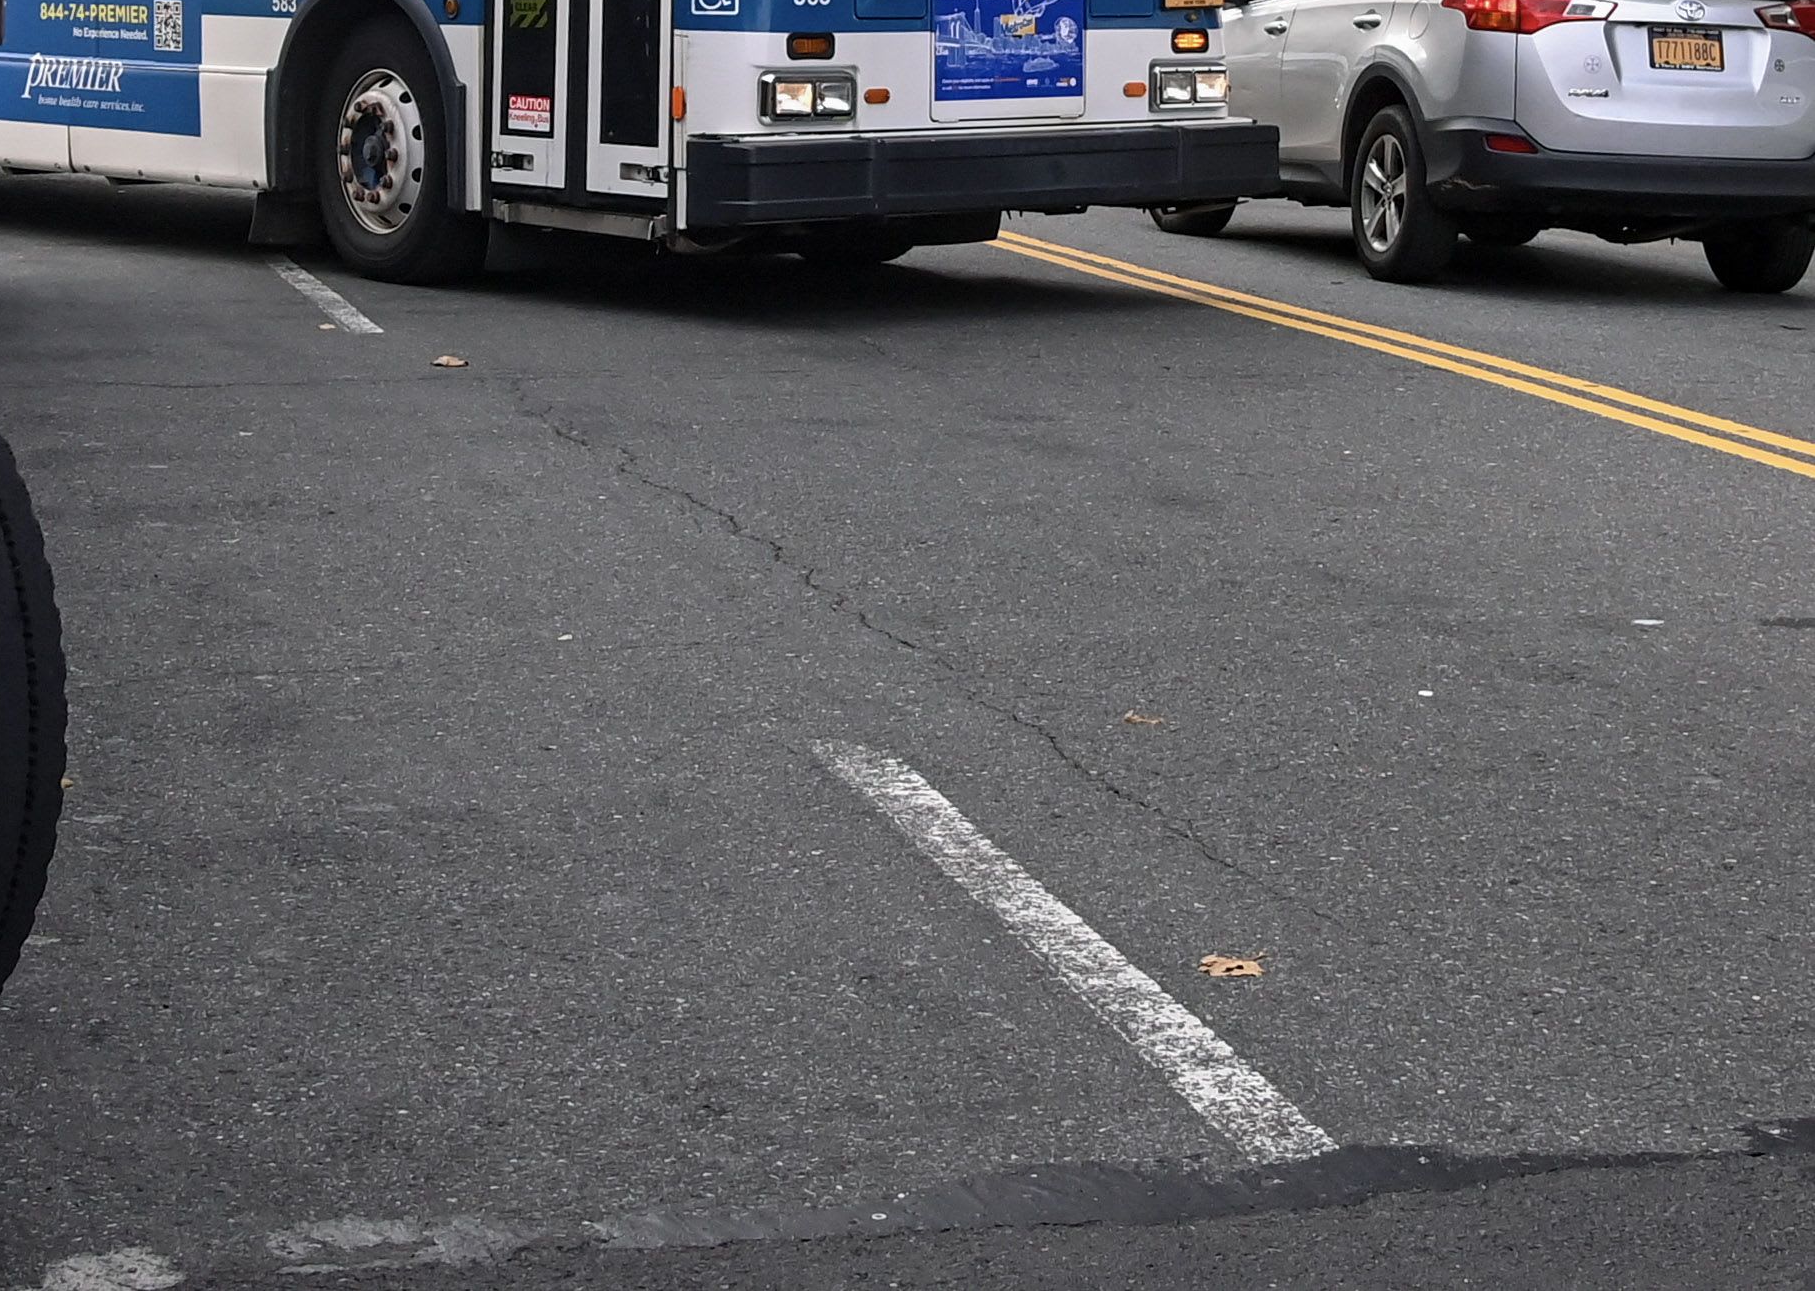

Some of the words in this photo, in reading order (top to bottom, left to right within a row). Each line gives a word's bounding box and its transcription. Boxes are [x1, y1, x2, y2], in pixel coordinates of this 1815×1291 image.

[40, 2, 148, 24] 844-74-PREMIER
[72, 27, 83, 38] No
[84, 27, 120, 40] Experience
[1656, 39, 1716, 62] T771188C
[509, 96, 551, 111] CAUTION
